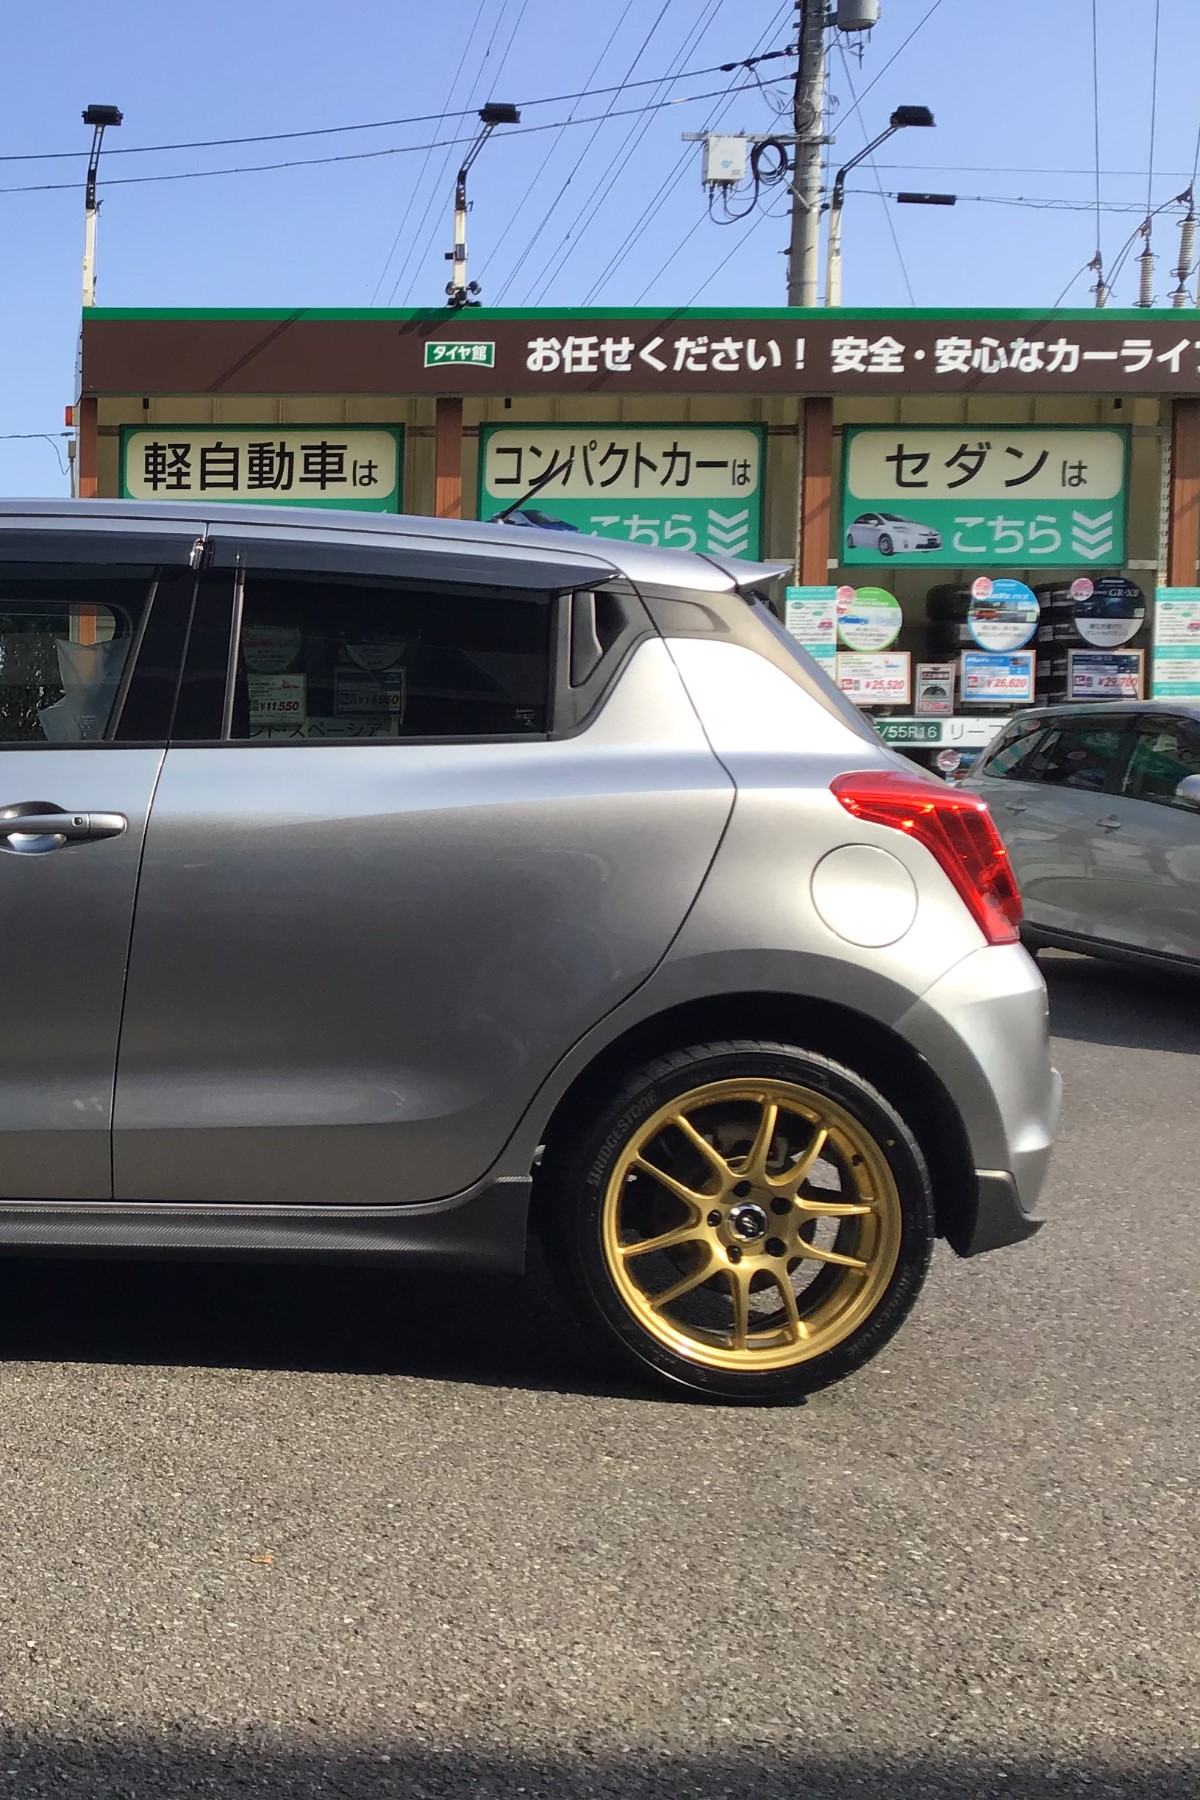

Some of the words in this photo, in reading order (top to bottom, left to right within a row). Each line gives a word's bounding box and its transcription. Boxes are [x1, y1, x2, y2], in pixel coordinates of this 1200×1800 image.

[433, 345, 488, 361] タイヤ館
[525, 336, 807, 374] お任せください！
[143, 441, 379, 491] 軽自動車は
[494, 439, 752, 488] コンパクトカーは
[885, 441, 1089, 489] セダンは
[952, 515, 1063, 554] こちら
[864, 680, 905, 692] ¥25,520
[986, 678, 1027, 690] ¥26,620
[1097, 676, 1138, 689] ¥29,700
[586, 1090, 657, 1186] BRIDGESTONE
